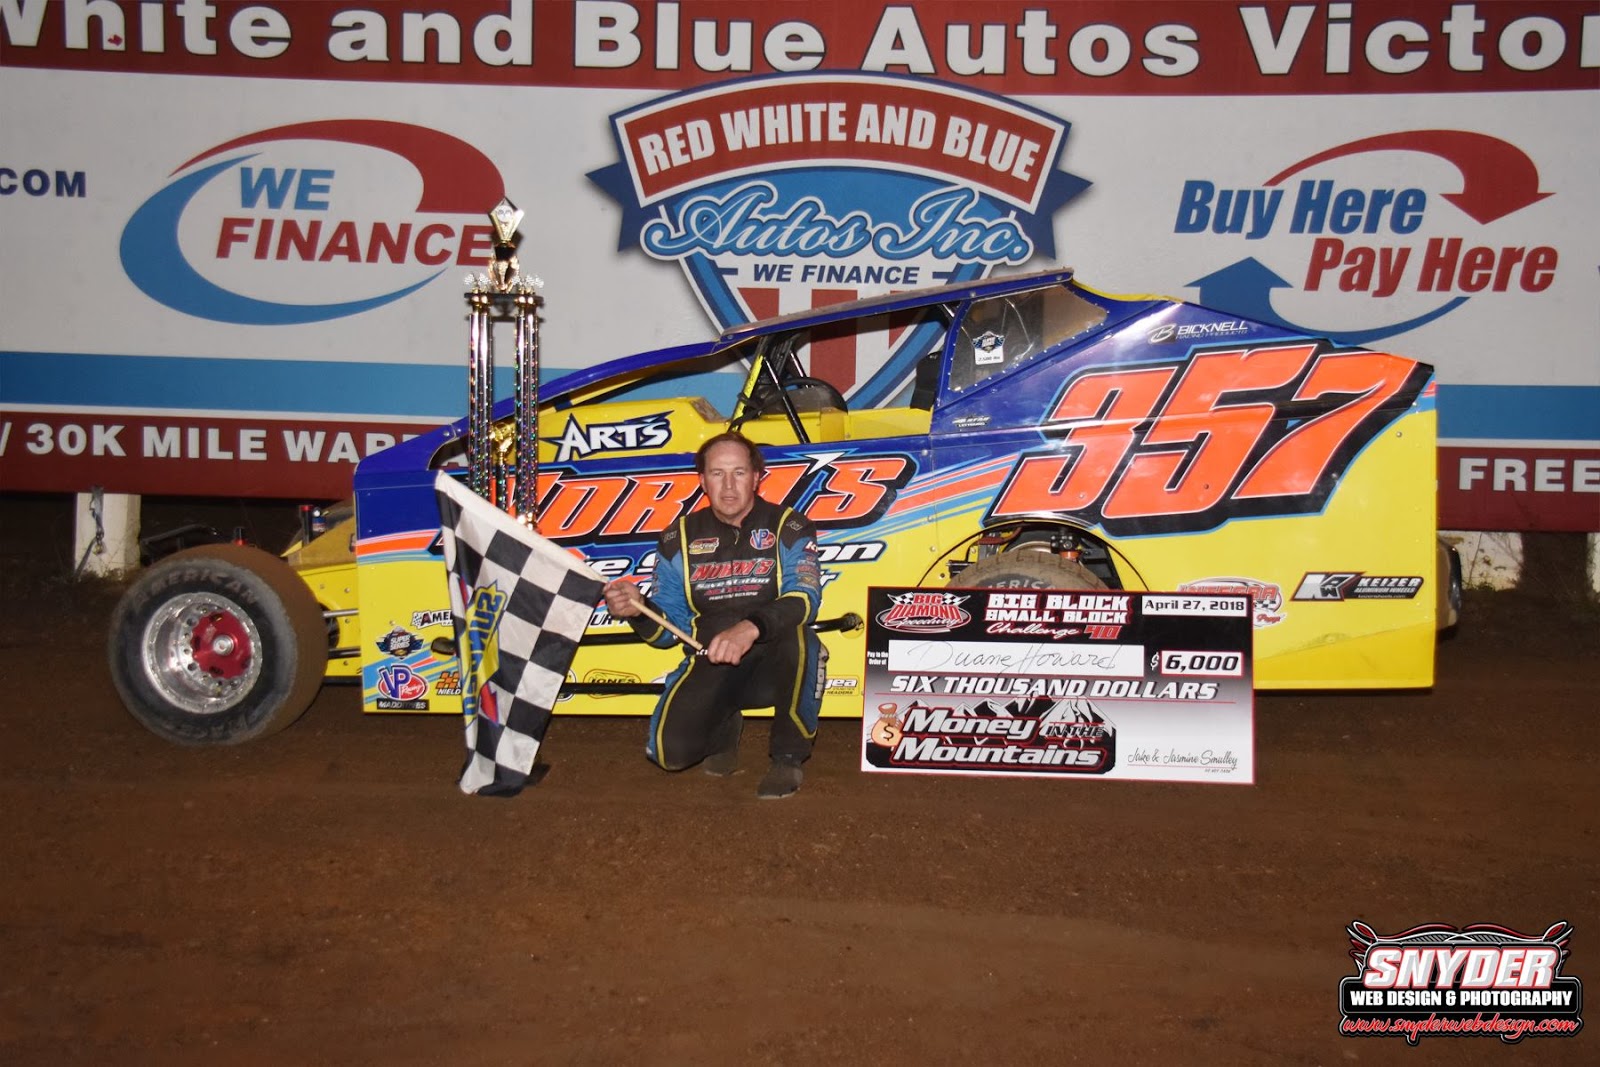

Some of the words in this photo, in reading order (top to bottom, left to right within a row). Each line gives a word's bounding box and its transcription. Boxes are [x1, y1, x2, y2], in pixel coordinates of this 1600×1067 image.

[327, 0, 534, 66] and
[574, 0, 826, 72] Blue
[859, 5, 1200, 77] Autos
[637, 120, 715, 176] RED
[720, 102, 847, 152] WHITE
[855, 104, 937, 151] AND
[941, 123, 1041, 182] BLUE
[239, 166, 335, 211] WE
[646, 184, 870, 256] Autos
[876, 187, 1030, 259] Inc.
[1173, 179, 1285, 240] Buy
[1289, 179, 1427, 235] Here
[216, 217, 494, 268] FINANCE
[753, 263, 794, 282] WE
[801, 264, 920, 285] FINANCE
[1303, 238, 1411, 298] Pay
[1417, 238, 1559, 293] Here
[1177, 321, 1248, 335] BICKNELL
[26, 422, 128, 457] 30K
[143, 426, 267, 461] MILE
[991, 343, 1417, 518] 357
[1459, 457, 1600, 492] FREE
[913, 593, 943, 604] BIG
[1358, 578, 1421, 587] KEIZER
[885, 604, 963, 623] DIAMOND
[985, 609, 1055, 622] SMALL
[1062, 611, 1128, 624] BLOCK
[987, 593, 1037, 609] BIG
[1046, 595, 1130, 611] BLOCK
[1144, 599, 1178, 611] April
[1183, 600, 1206, 611] 27,
[1209, 600, 1245, 611] 2018
[986, 622, 1080, 640] Challenge
[1084, 625, 1123, 640] 40
[907, 640, 1010, 671] Duane
[1003, 640, 1124, 674] Howard
[1150, 652, 1160, 671] $
[1165, 654, 1239, 672] 6,000
[379, 666, 412, 700] VP
[890, 675, 937, 693] SIX
[943, 676, 1088, 697] THOUSAND
[1090, 680, 1218, 699] DOLLARS
[903, 708, 1037, 740] Money
[1070, 725, 1105, 738] THE
[894, 737, 1101, 766] Mountains
